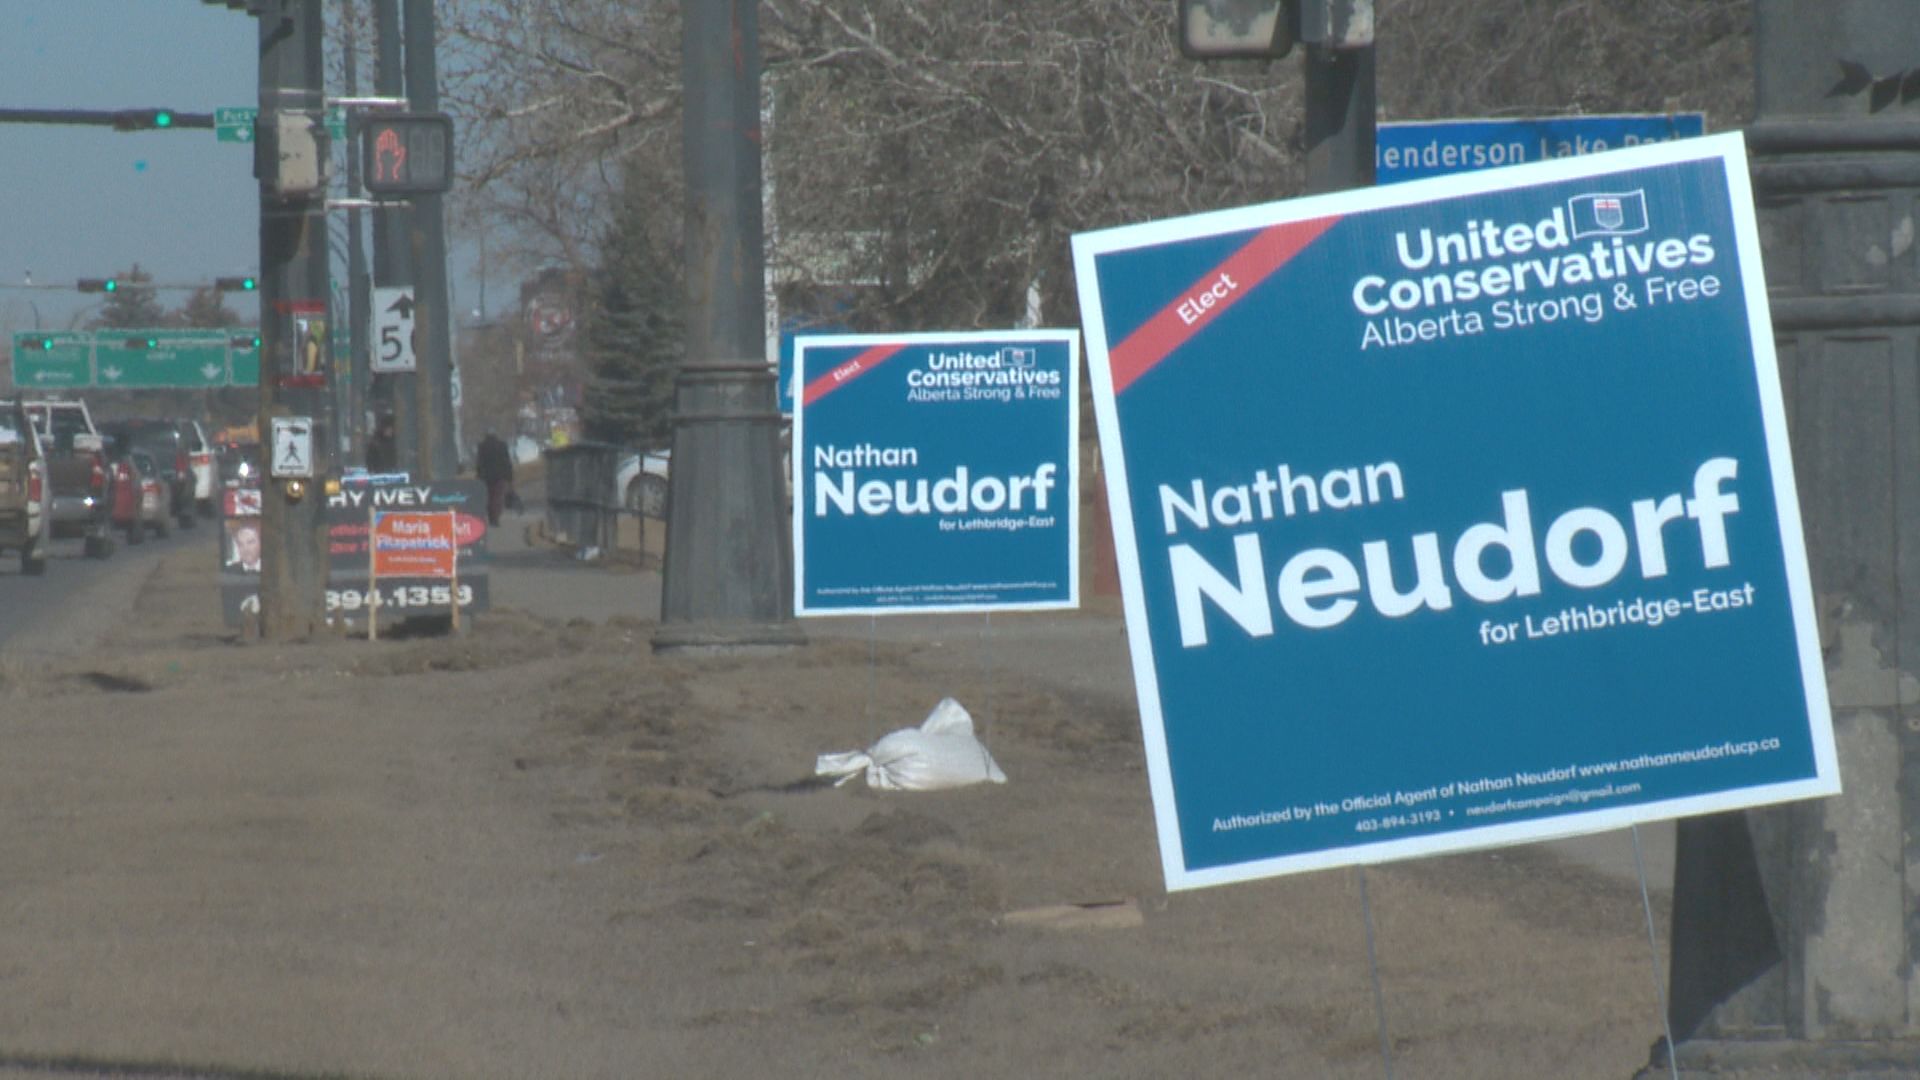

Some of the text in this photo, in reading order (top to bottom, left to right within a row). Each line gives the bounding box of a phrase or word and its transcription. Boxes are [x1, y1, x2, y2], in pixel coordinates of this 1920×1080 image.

[1395, 206, 1569, 270] United
[1176, 272, 1237, 325] Elect
[1352, 233, 1716, 315] Conservatives
[1361, 274, 1721, 351] Alberta Strong & Free
[832, 360, 862, 382] Elect
[907, 366, 1060, 388] Conservatives
[928, 351, 1001, 370] United
[907, 387, 960, 402] Alberta
[963, 385, 1010, 403] Strong
[1029, 383, 1060, 399] Free
[814, 443, 918, 469] Nathan
[373, 487, 431, 506] IVEY
[814, 462, 1057, 517] Neudorf
[1158, 460, 1404, 535] Nathan
[939, 515, 1055, 533] for Lethbridge-East
[1168, 457, 1740, 648] Neudorf
[1479, 582, 1755, 645] for Lethbridge-East
[1212, 737, 1780, 832] Authorized by the Official Agent of Nathan Neudorf www.nathanneudorfucp.ca
